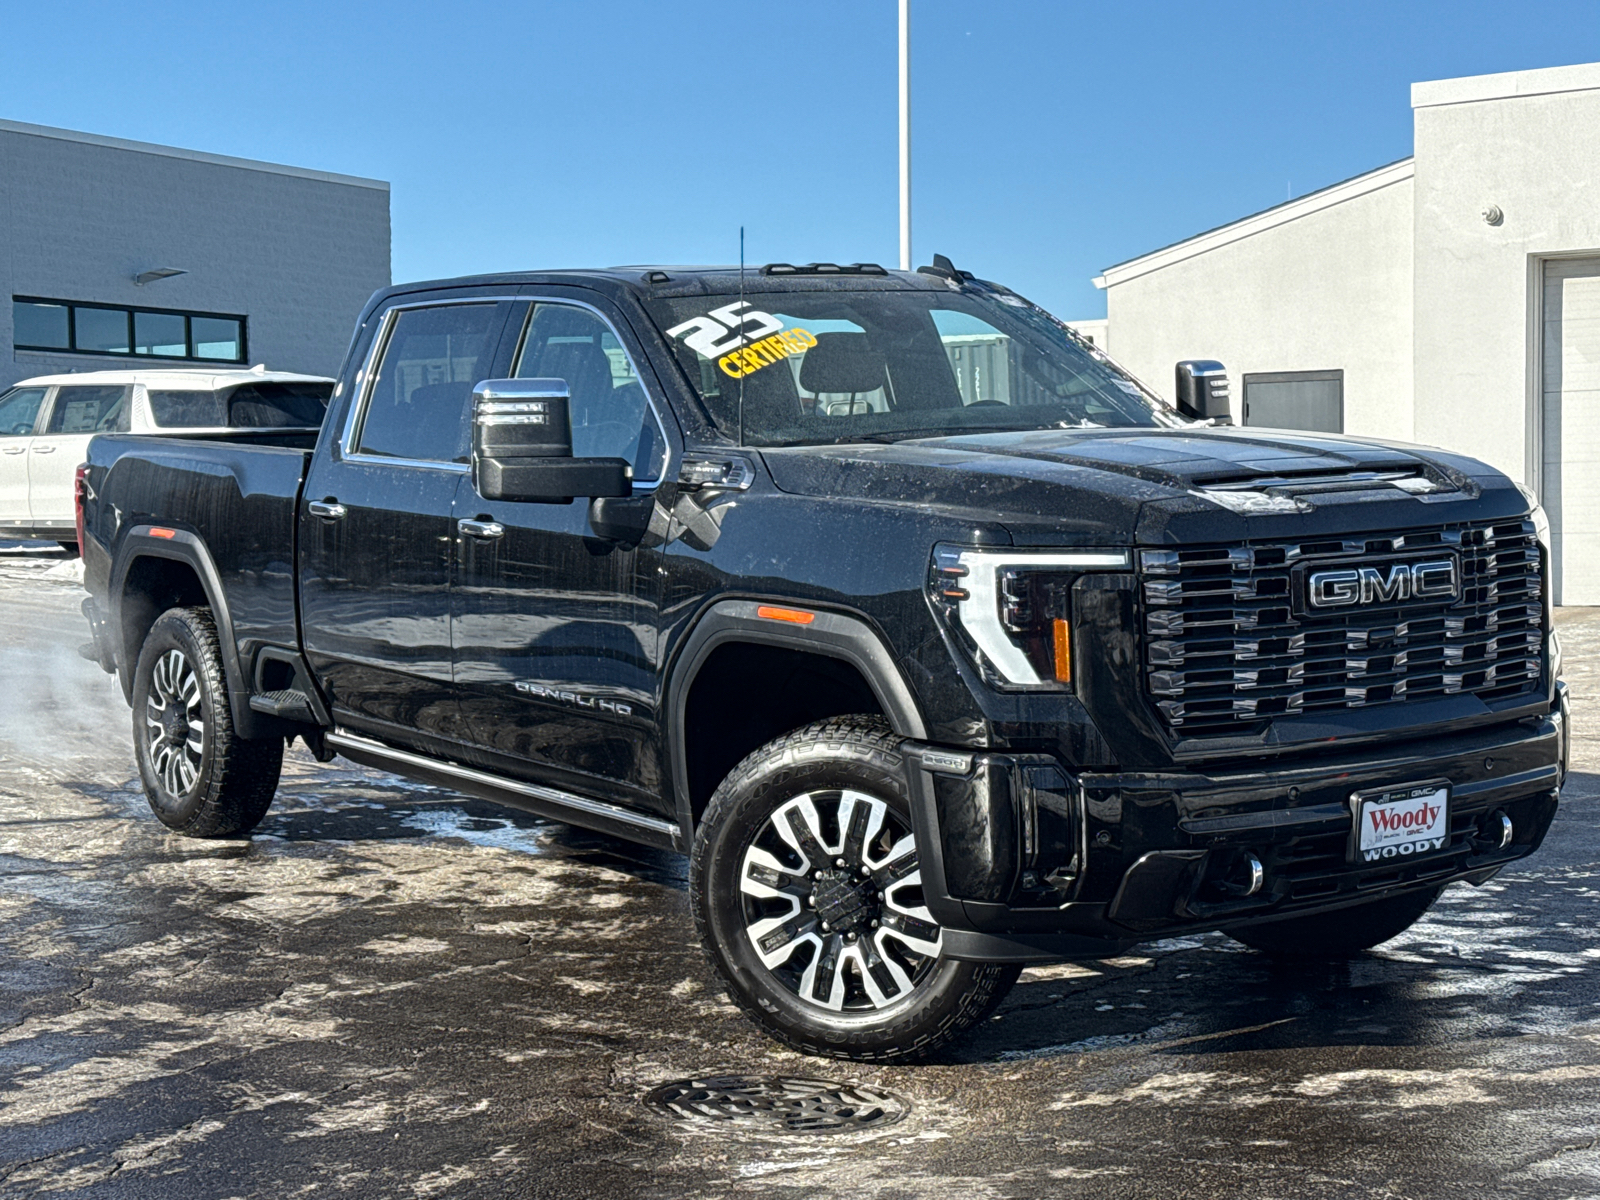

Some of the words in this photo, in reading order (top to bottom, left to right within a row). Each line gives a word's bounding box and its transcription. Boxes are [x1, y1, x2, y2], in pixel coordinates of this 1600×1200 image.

[665, 301, 784, 359] 25
[718, 327, 818, 379] CERTIFIED
[1309, 561, 1455, 607] GMC
[515, 681, 595, 708] DENALI
[599, 699, 632, 716] HD
[736, 761, 908, 818] GOODYEA
[1411, 787, 1433, 797] GMC
[1369, 802, 1442, 833] Woody
[1406, 827, 1425, 836] GMC
[1363, 837, 1446, 862] WOODY
